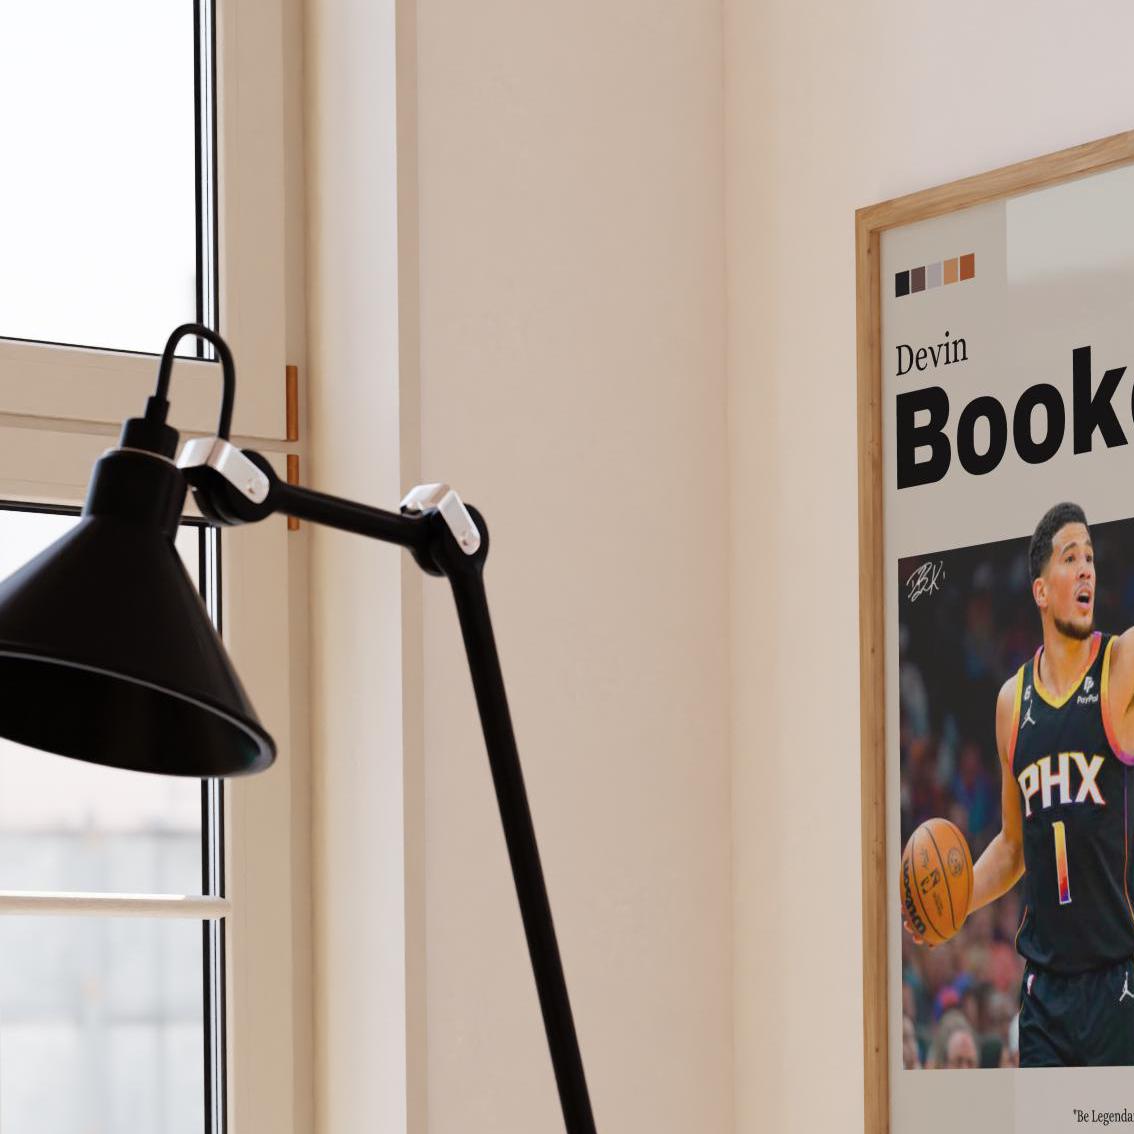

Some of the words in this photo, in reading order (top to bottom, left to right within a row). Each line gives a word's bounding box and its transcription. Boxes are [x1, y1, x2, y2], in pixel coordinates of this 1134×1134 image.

[896, 330, 968, 377] Devin
[1076, 693, 1099, 704] PayPal
[1018, 751, 1106, 817] PHX
[1052, 820, 1072, 904] 1
